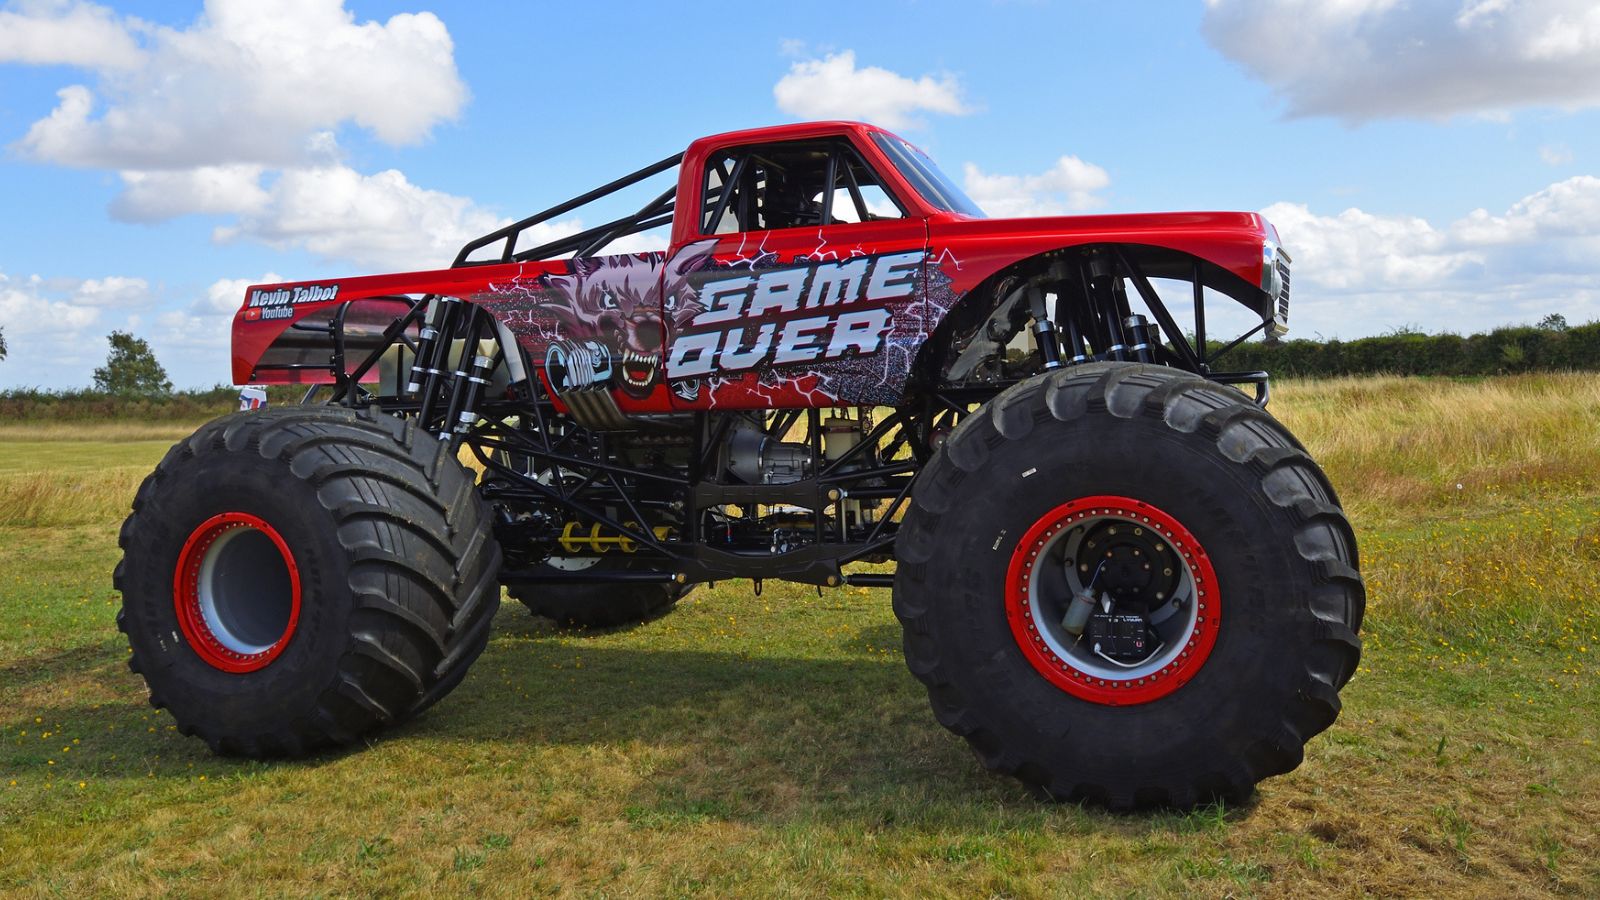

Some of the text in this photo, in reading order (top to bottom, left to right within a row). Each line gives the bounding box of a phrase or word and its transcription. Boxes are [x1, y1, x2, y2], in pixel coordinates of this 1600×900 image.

[249, 285, 339, 307] Kevin Talbot
[693, 250, 930, 326] GAME
[262, 305, 294, 320] YouTube
